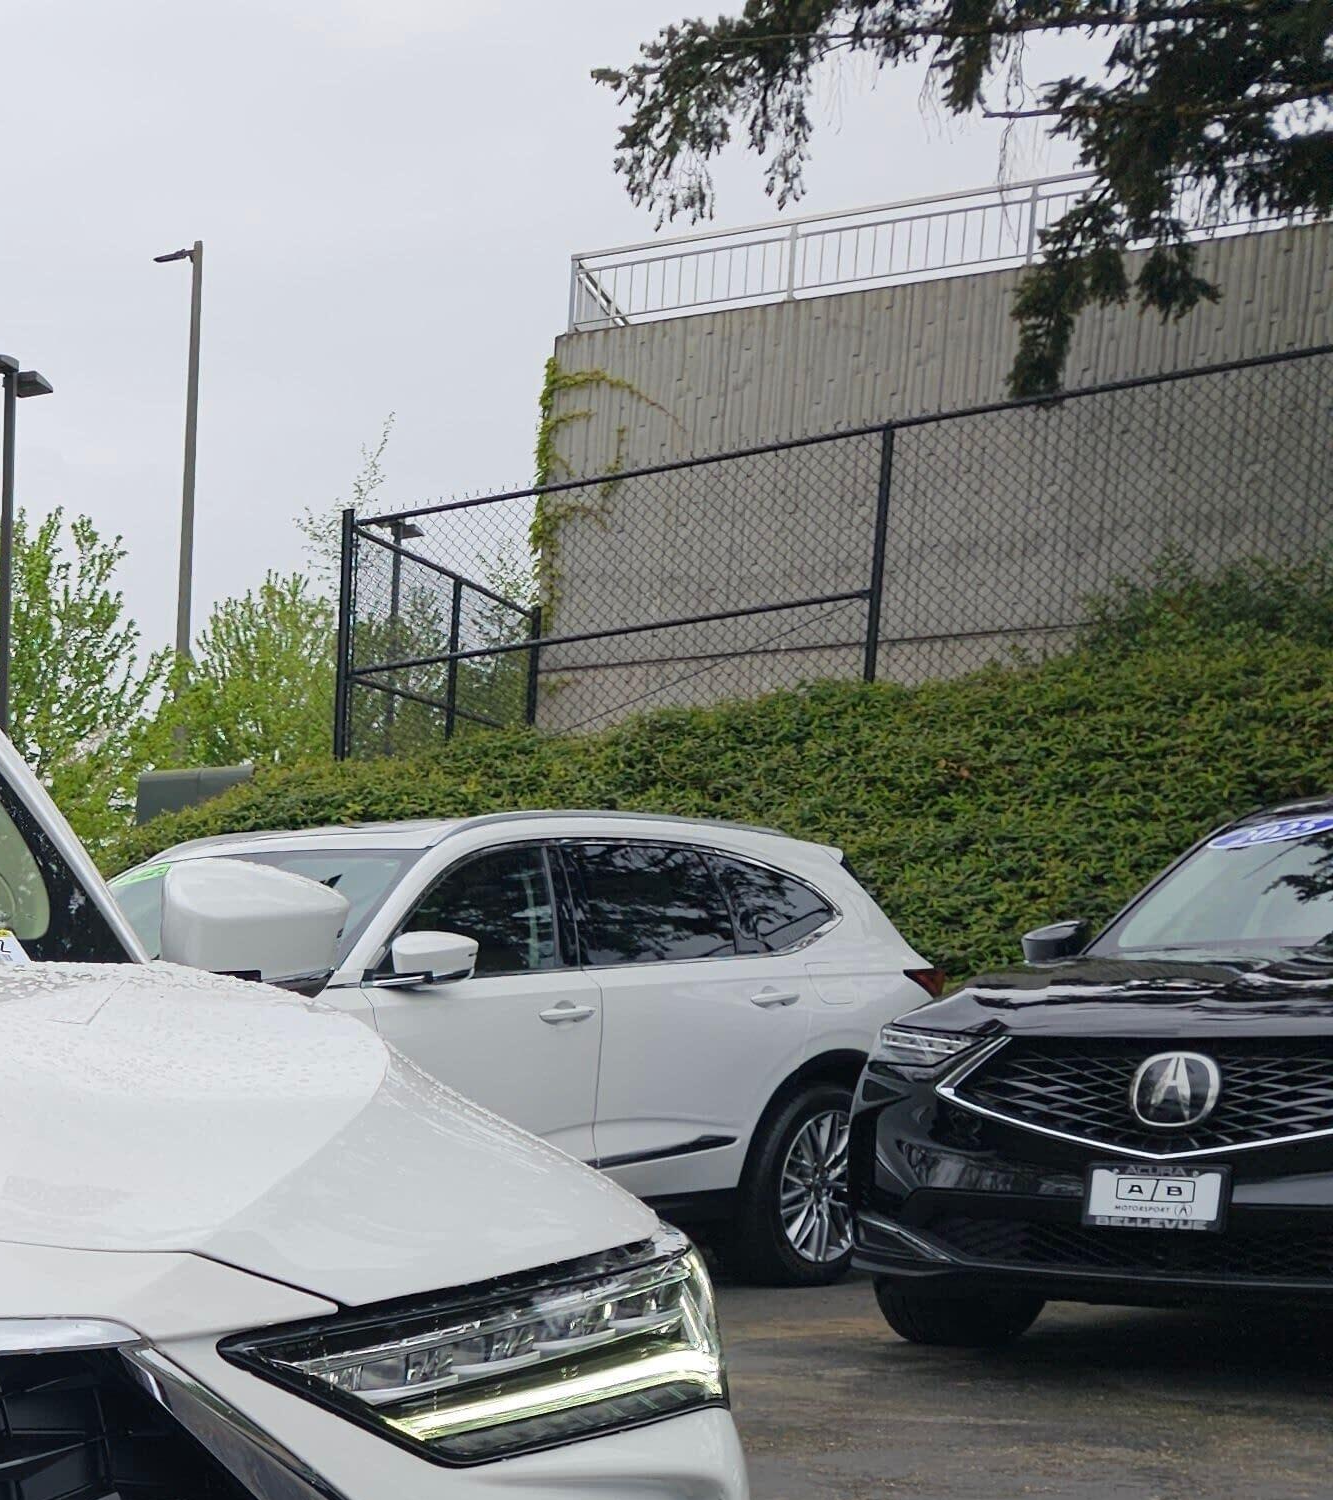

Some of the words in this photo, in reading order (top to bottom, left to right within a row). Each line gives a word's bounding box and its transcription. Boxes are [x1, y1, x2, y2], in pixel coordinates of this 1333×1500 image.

[1124, 1165, 1188, 1177] ACURA
[1114, 1205, 1170, 1213] MOTORSPORT
[1095, 1215, 1207, 1231] BELLEVUE
